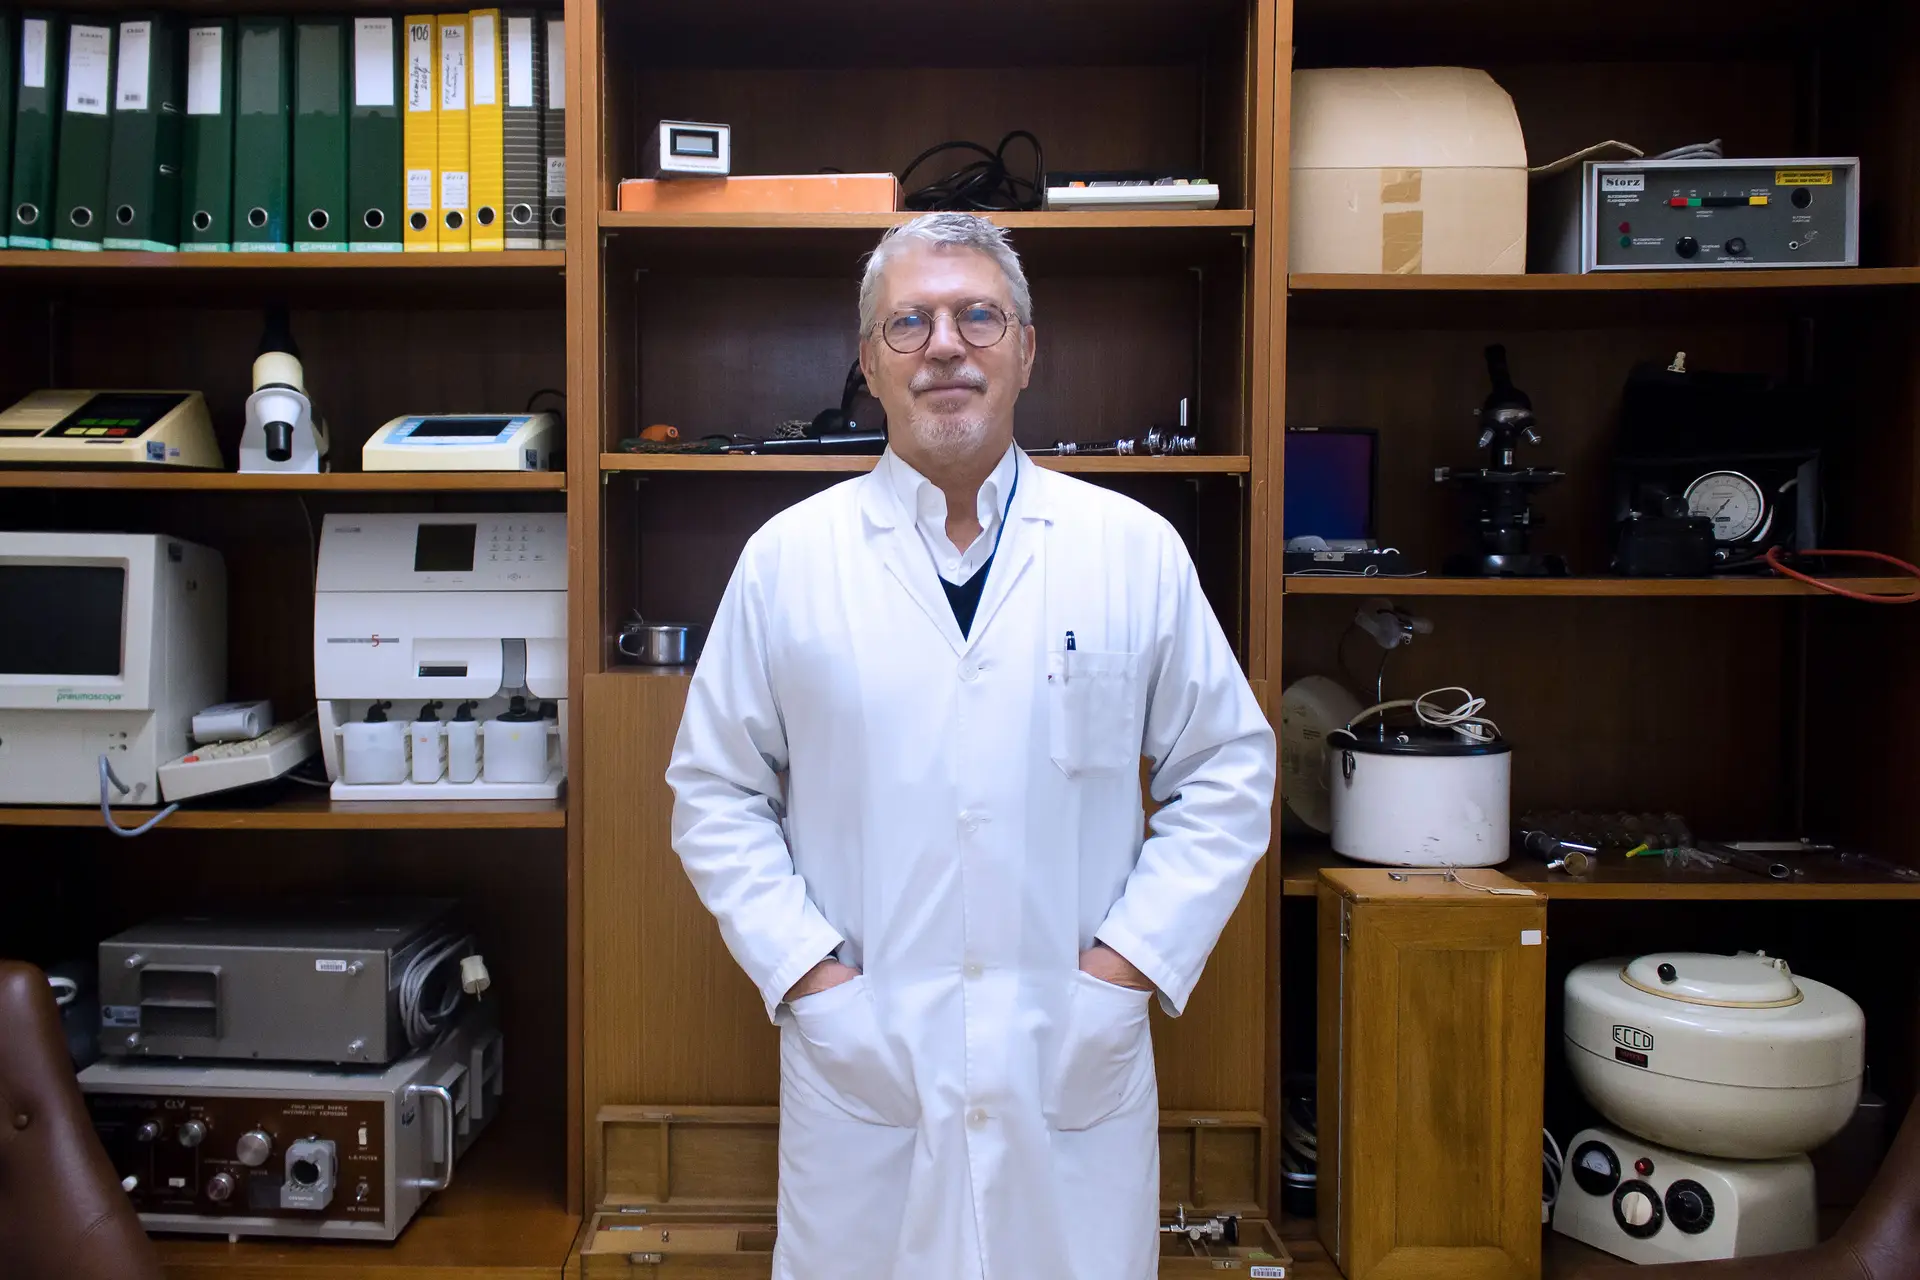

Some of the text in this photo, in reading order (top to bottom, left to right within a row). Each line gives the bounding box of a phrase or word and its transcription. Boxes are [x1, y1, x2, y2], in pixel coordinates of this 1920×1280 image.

[410, 25, 429, 42] 106
[1606, 177, 1641, 187] Storz
[371, 634, 380, 648] 5
[57, 693, 121, 703] pneumoscope
